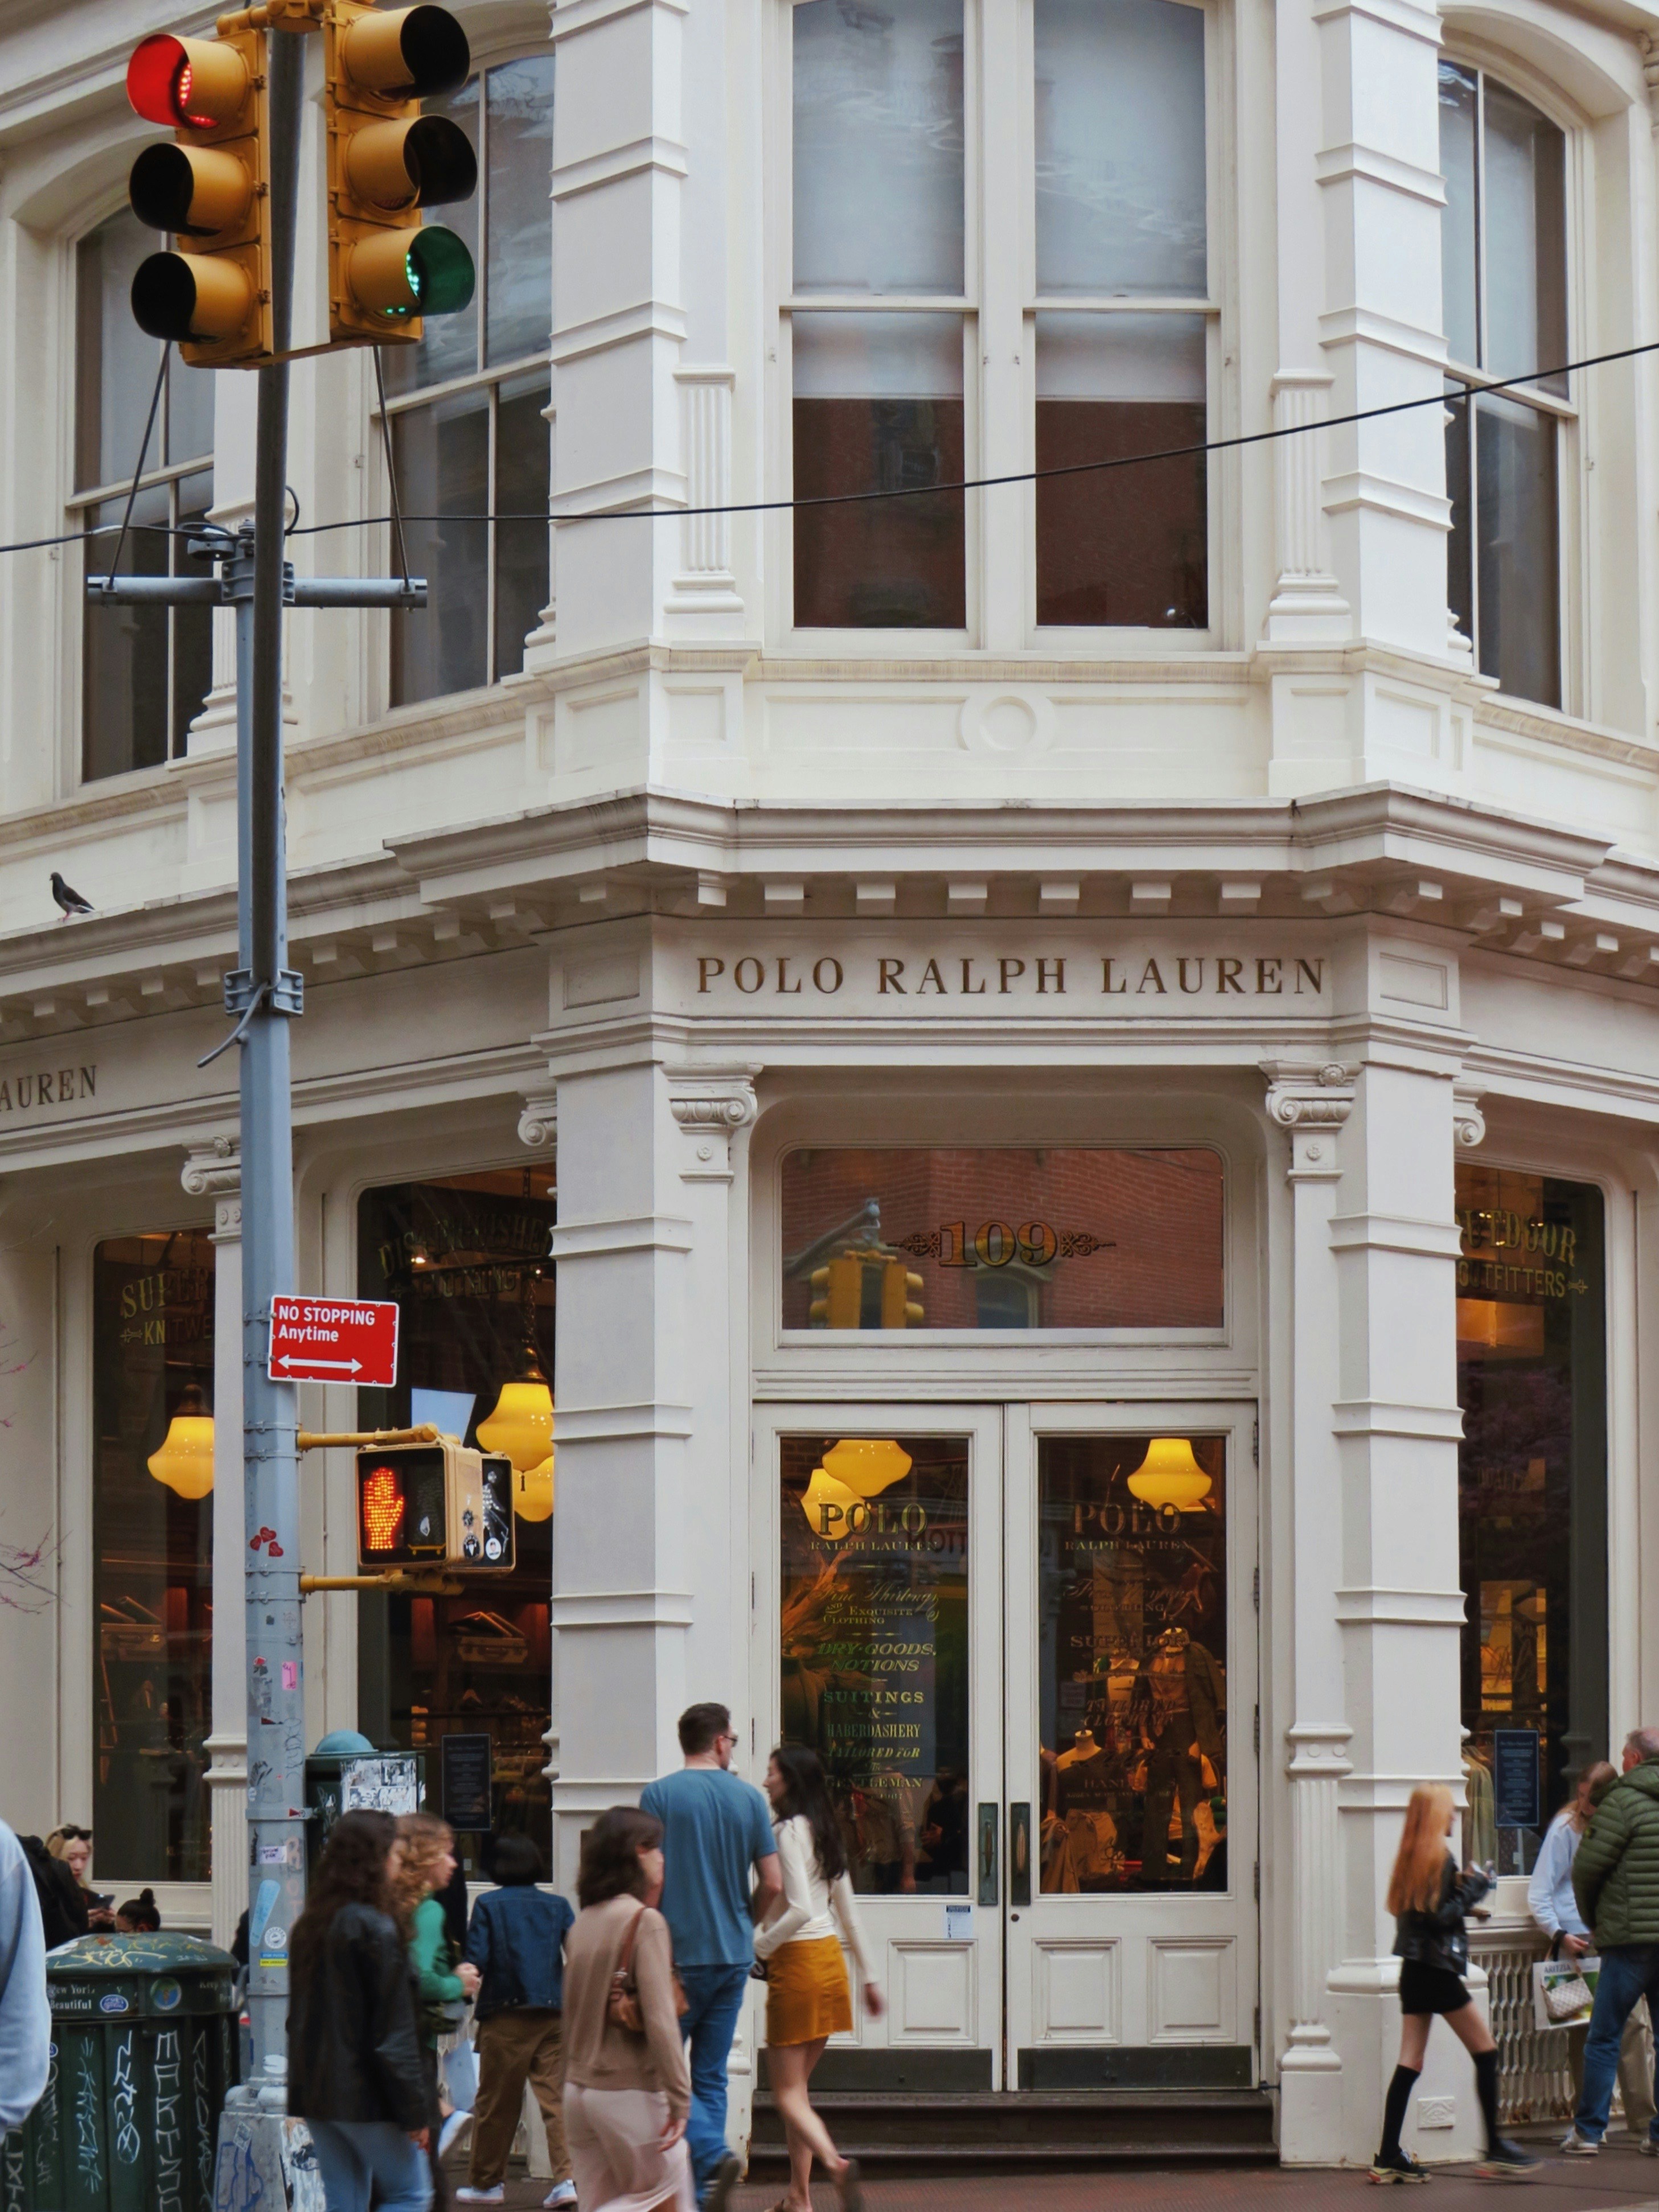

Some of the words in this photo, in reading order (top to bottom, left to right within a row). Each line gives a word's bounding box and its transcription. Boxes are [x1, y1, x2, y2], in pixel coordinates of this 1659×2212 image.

[696, 957, 844, 995] POLO
[876, 957, 1067, 995] RALPH
[1100, 957, 1325, 995] LAUREN
[0, 1065, 97, 1111] AUREN
[939, 1220, 1058, 1267] 109
[1459, 1260, 1566, 1298] OUTFITTERS
[278, 1305, 299, 1321] NO
[303, 1306, 376, 1326] STOPPING
[278, 1323, 339, 1343] Anytime
[818, 1502, 928, 1535] POLO
[1074, 1502, 1182, 1535] POLO
[810, 1541, 865, 1551] RALPH
[871, 1541, 938, 1551] LAUREN
[1065, 1541, 1119, 1551] RALPH
[831, 1659, 920, 1672] NOTIONS
[824, 1691, 925, 1704] SUITINGS
[868, 1708, 881, 1719] &
[827, 1723, 921, 1737] HABERDASHERY
[827, 1747, 894, 1758] TAILORED
[896, 1747, 921, 1758] FOR
